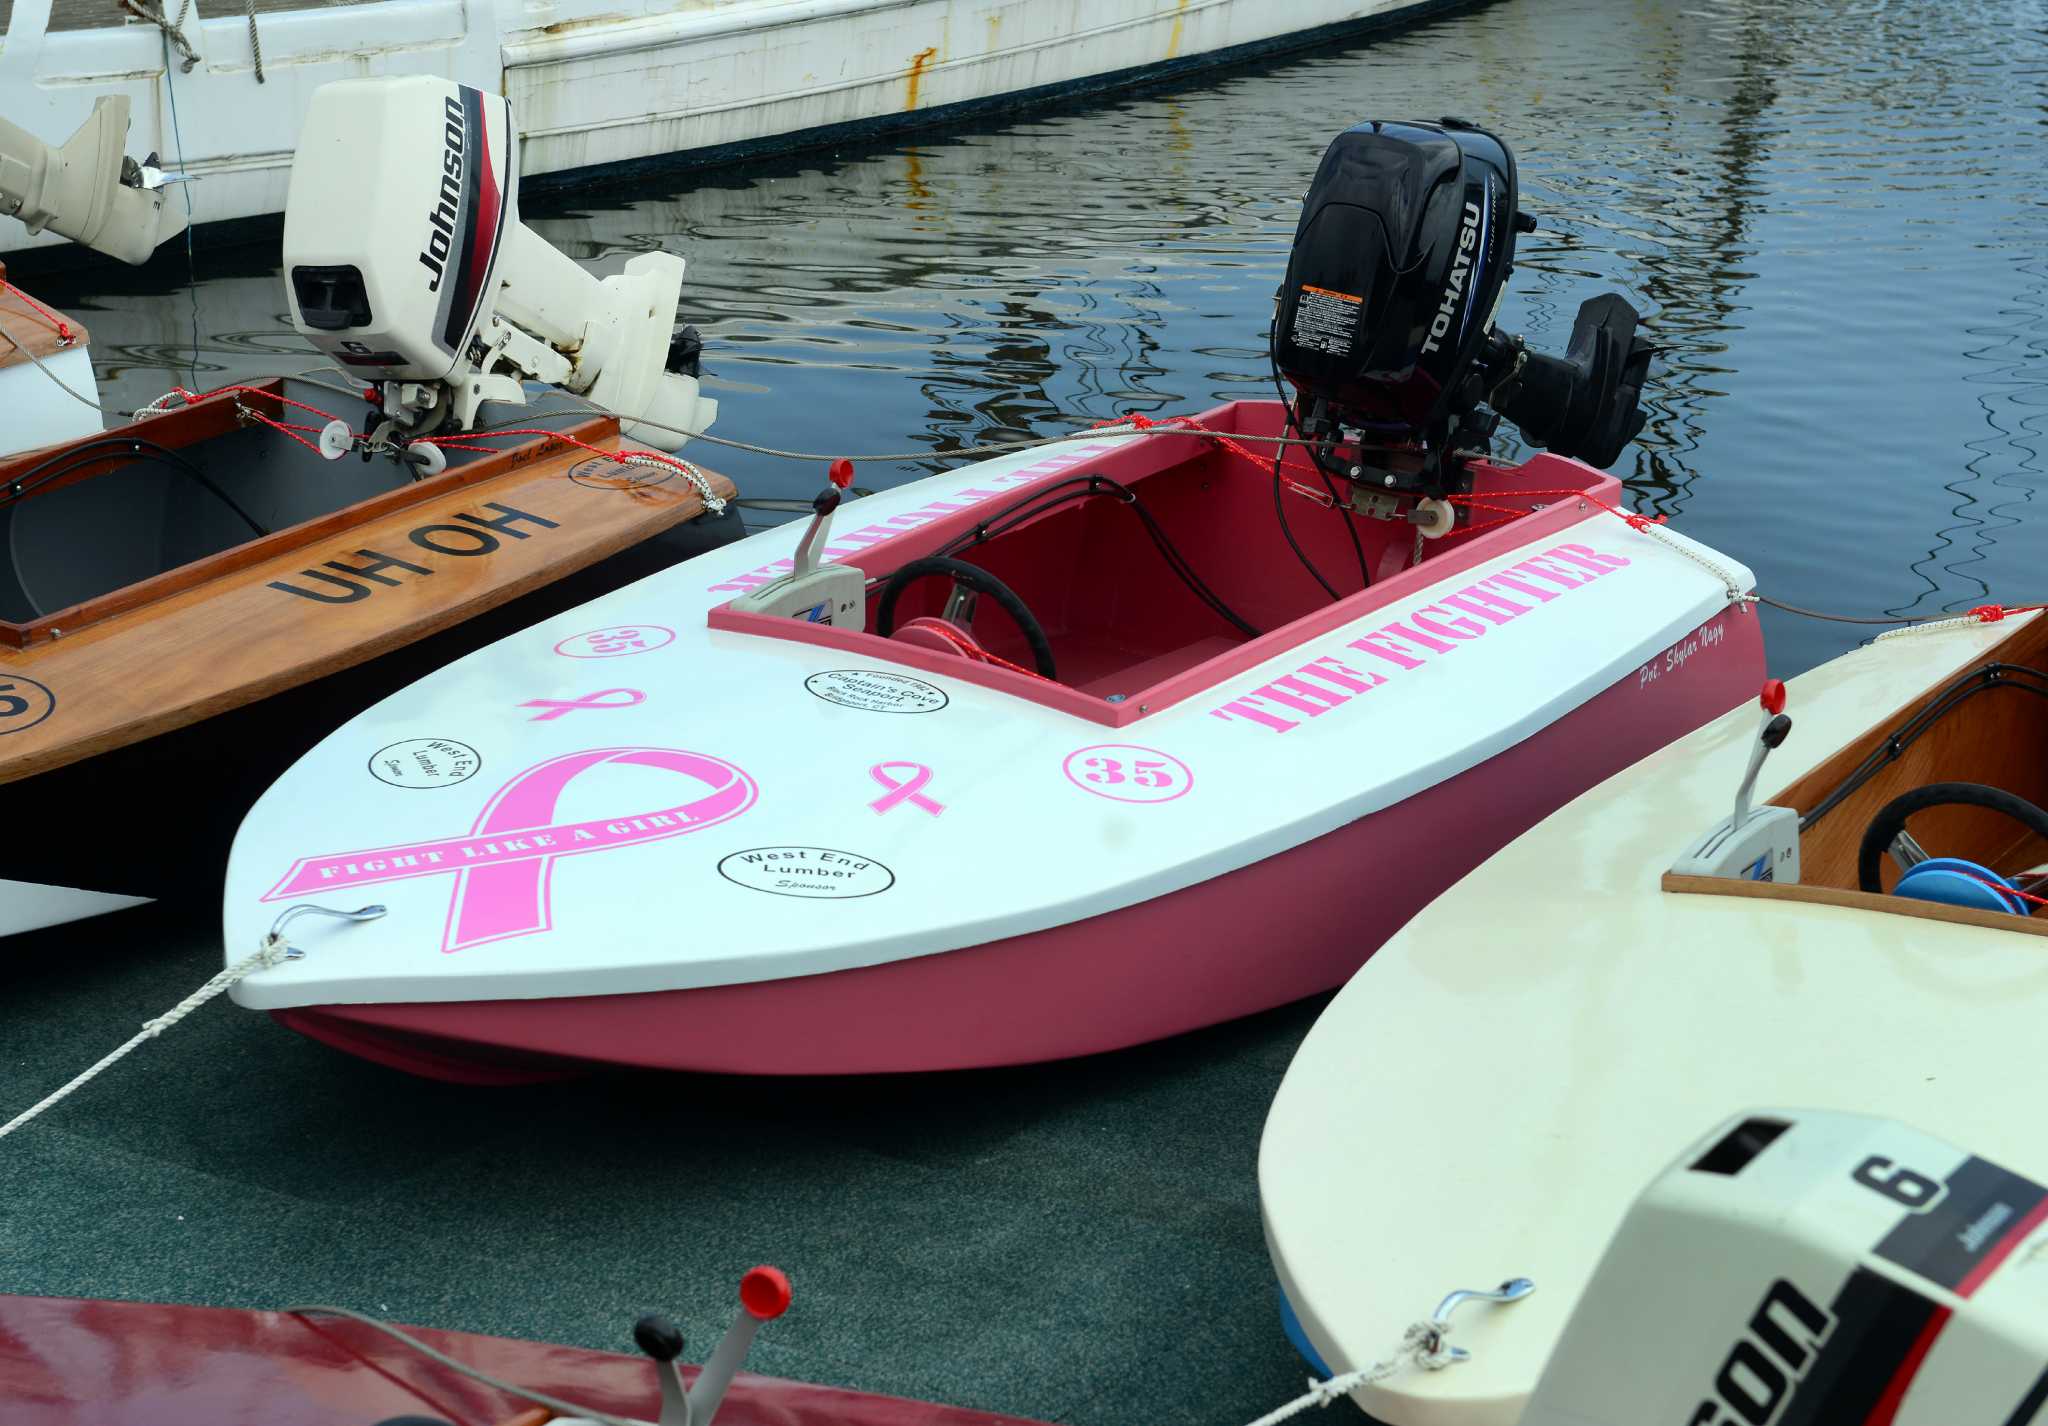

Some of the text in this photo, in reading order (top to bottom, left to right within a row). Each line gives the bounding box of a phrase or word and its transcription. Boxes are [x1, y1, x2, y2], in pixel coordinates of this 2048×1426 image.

[419, 95, 465, 292] Johnson
[1420, 201, 1480, 354] TOHATSU
[266, 502, 561, 604] UH OH
[1208, 543, 1632, 734] THE FIGHTER
[1666, 640, 1697, 672] Skylar
[1699, 623, 1724, 647] Nagy
[827, 673, 939, 704] Captain's Cove
[842, 683, 904, 702] Seaport
[412, 750, 440, 777] Lumber
[427, 741, 473, 777] West End
[1085, 758, 1173, 787] 35
[319, 811, 700, 880] FIGHT LIKE A GIRL
[740, 851, 871, 870] West End
[763, 864, 857, 879] Lumber
[775, 879, 837, 891] Sponsor
[1852, 1155, 1943, 1208] 6
